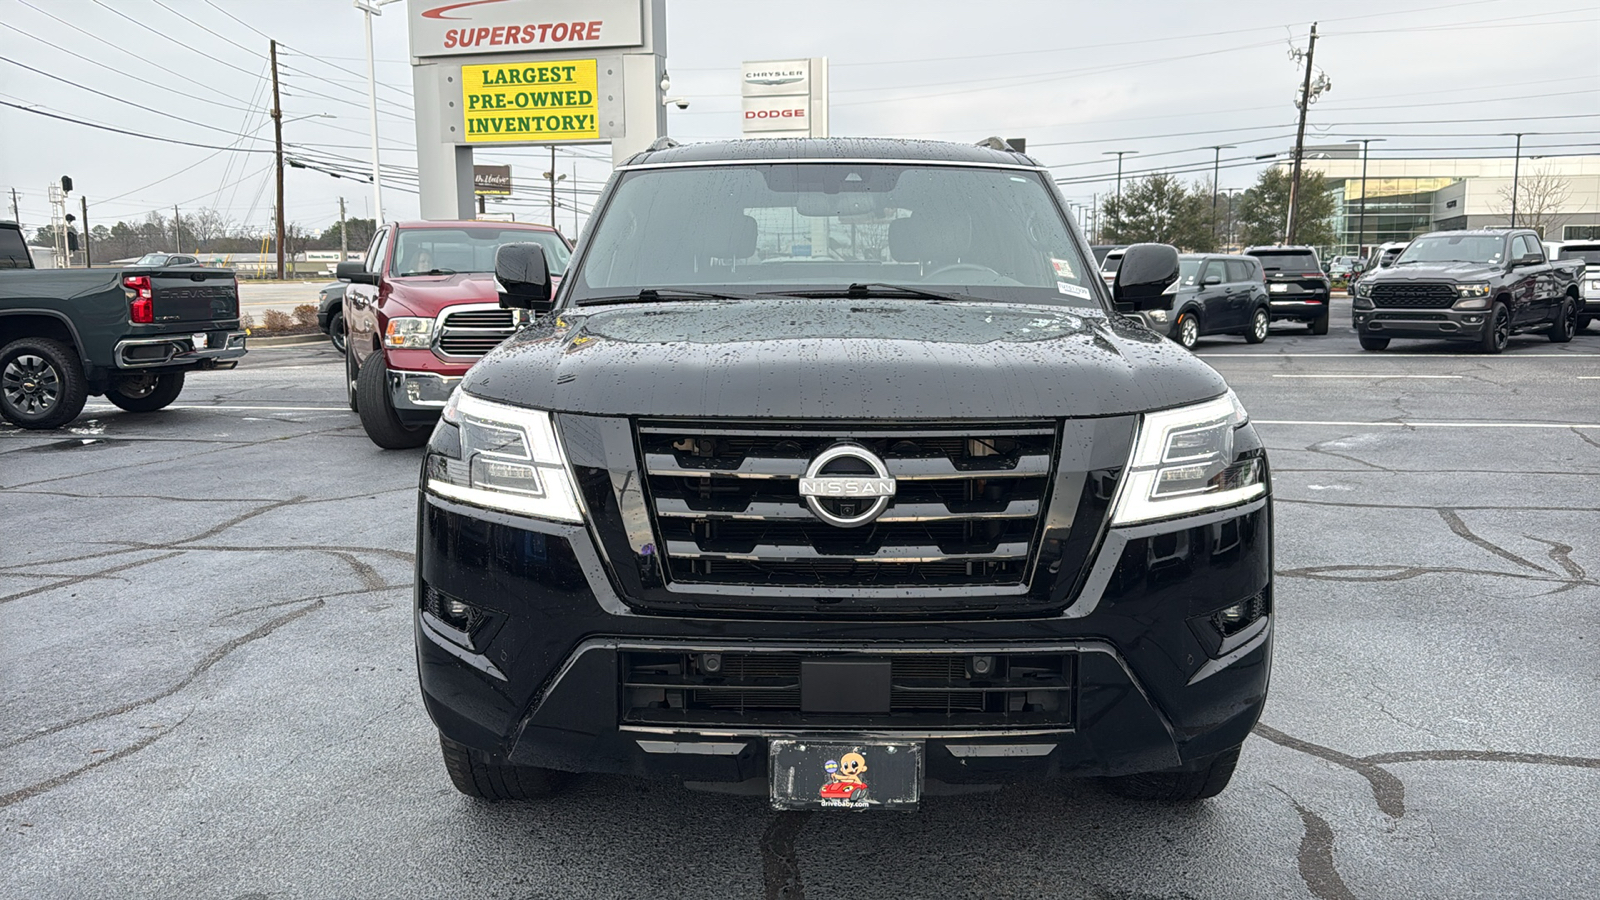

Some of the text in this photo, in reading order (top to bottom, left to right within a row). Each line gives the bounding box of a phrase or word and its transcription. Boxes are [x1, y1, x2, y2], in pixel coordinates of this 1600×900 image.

[443, 20, 603, 49] SUPERSTORE
[482, 66, 576, 84] LARGEST
[745, 70, 804, 79] CHRYSLER
[468, 90, 593, 110] PRE-OWNED
[745, 109, 805, 120] DODGE
[467, 114, 595, 134] INVENTORY!
[802, 482, 893, 493] NISSAN
[820, 799, 869, 808] drivebaby.com
